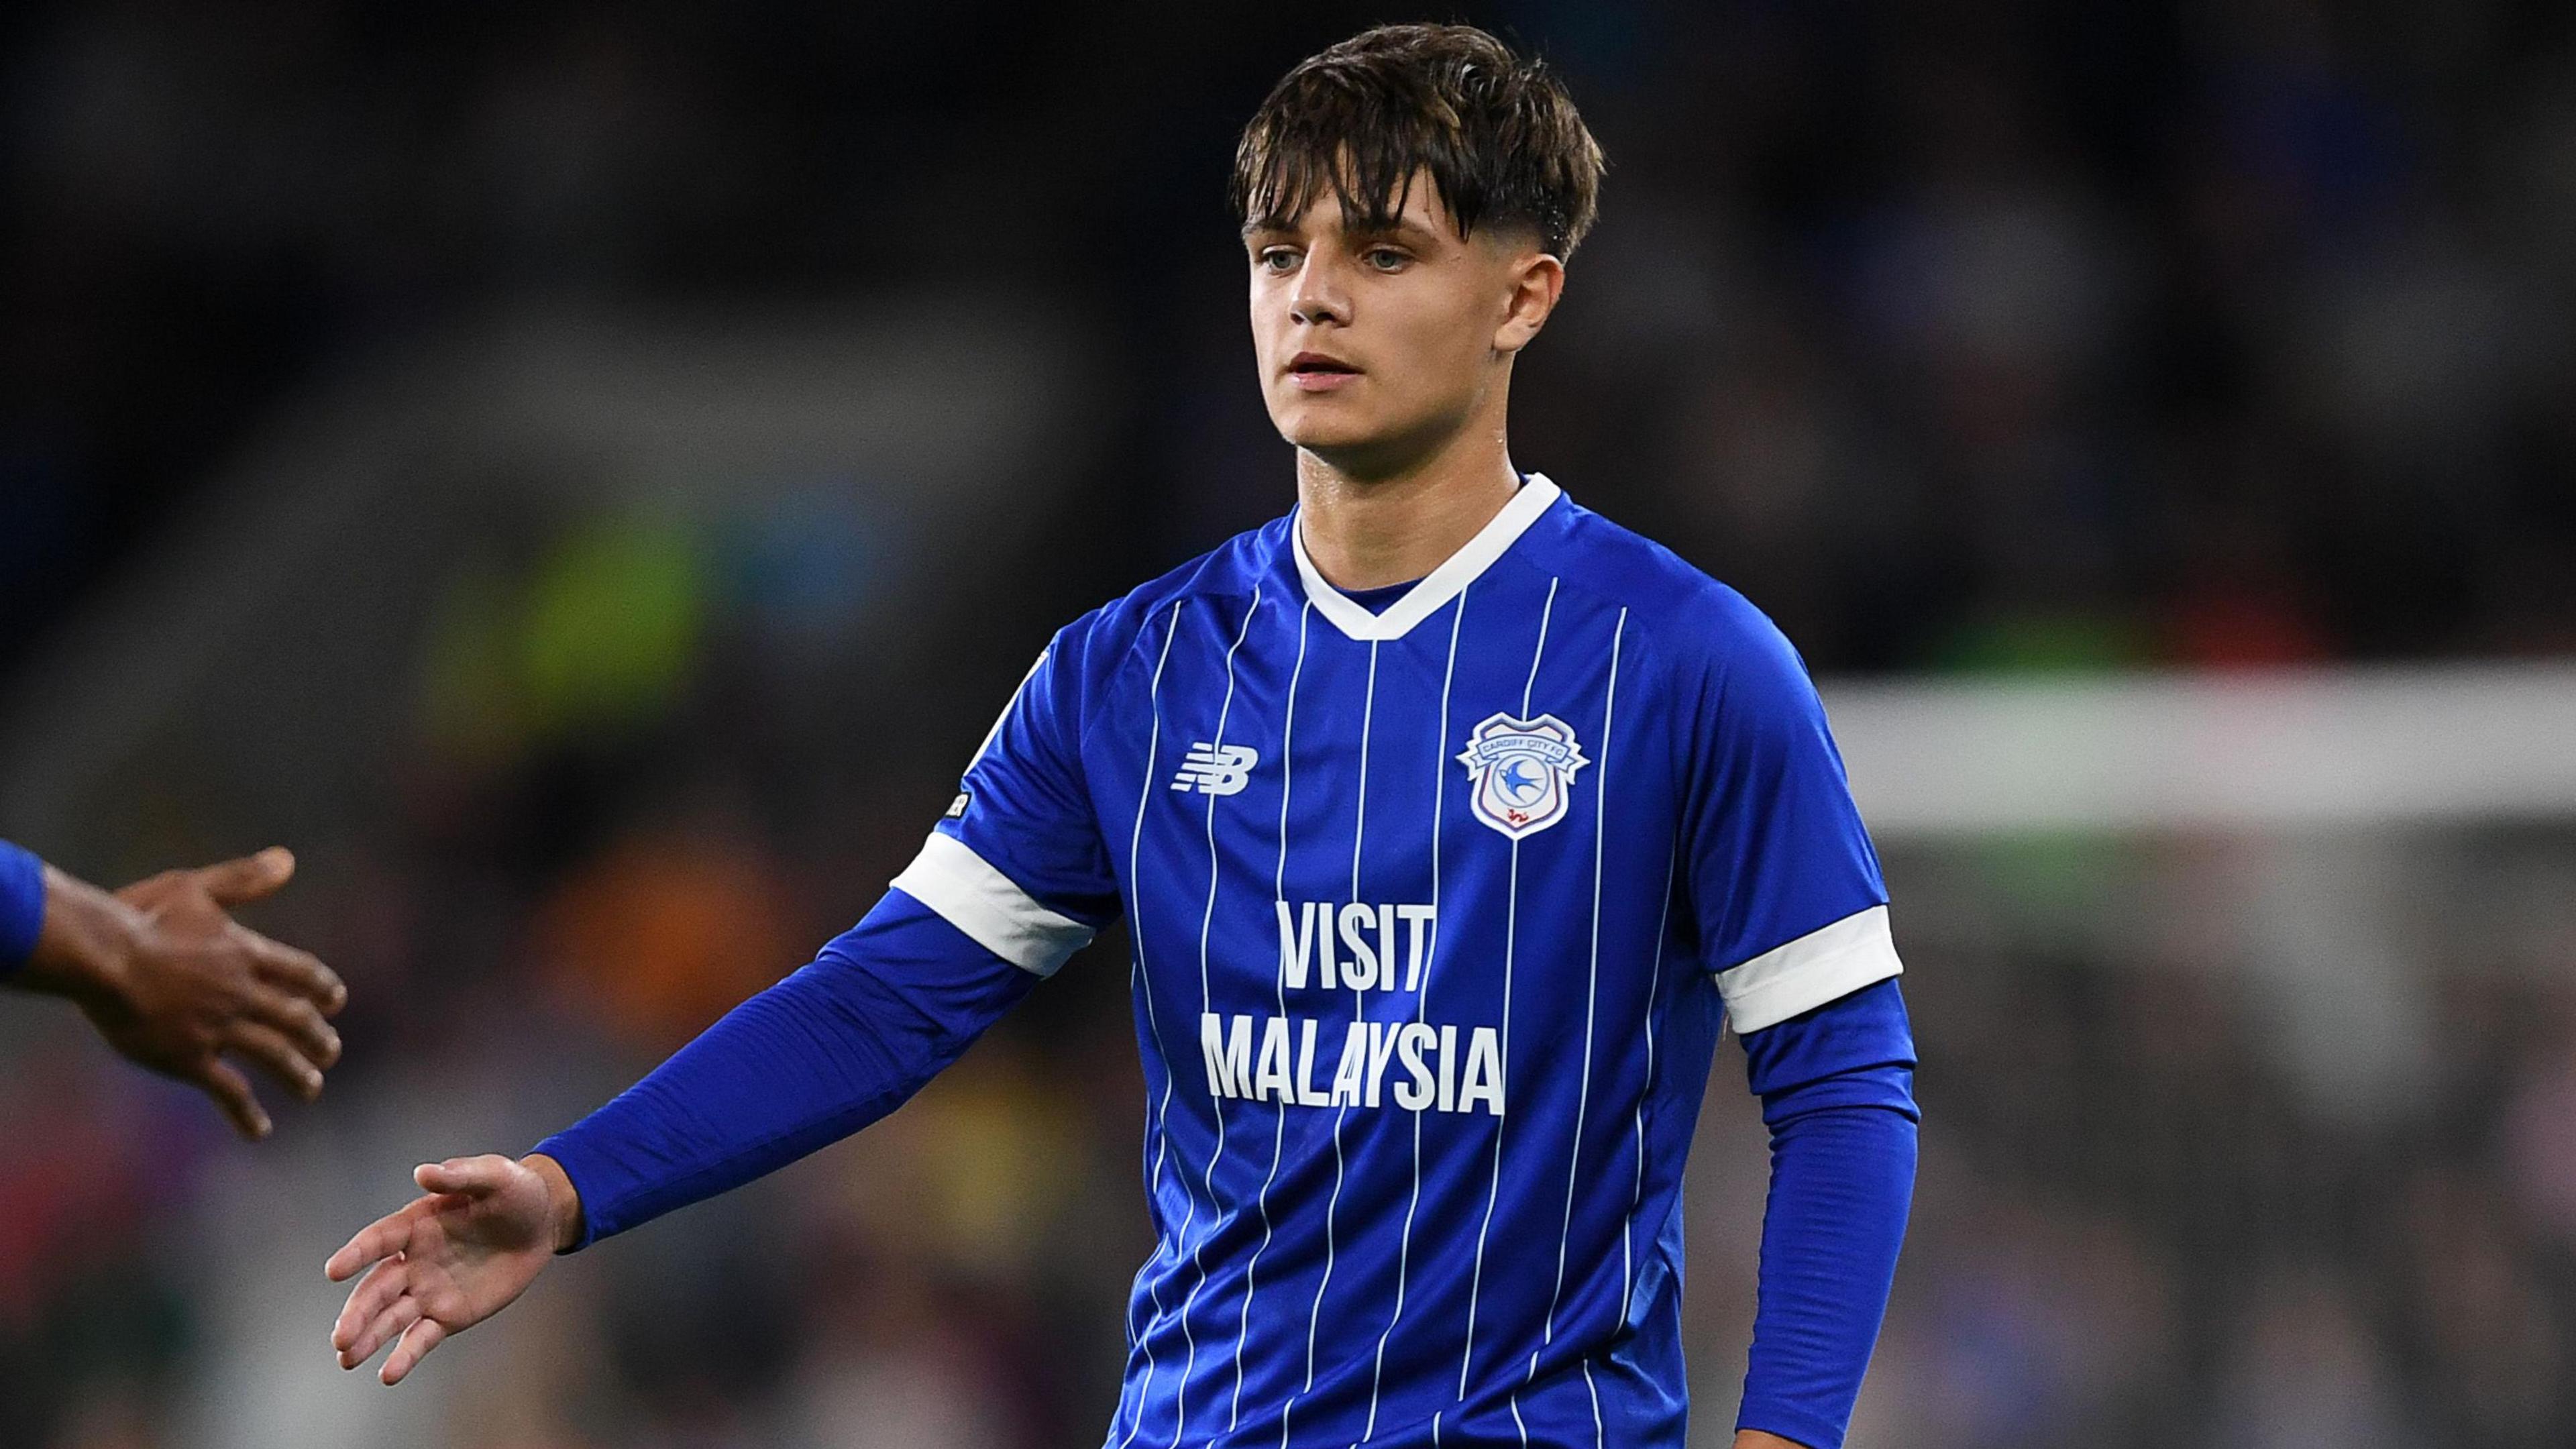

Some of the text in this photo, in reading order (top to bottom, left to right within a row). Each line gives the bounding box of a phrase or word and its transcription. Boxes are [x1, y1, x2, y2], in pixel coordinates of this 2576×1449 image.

[1483, 739, 1564, 756] CARDIFF CITY FC
[1275, 900, 1435, 991] VISIT
[1201, 1012, 1505, 1115] MALAYSIA
